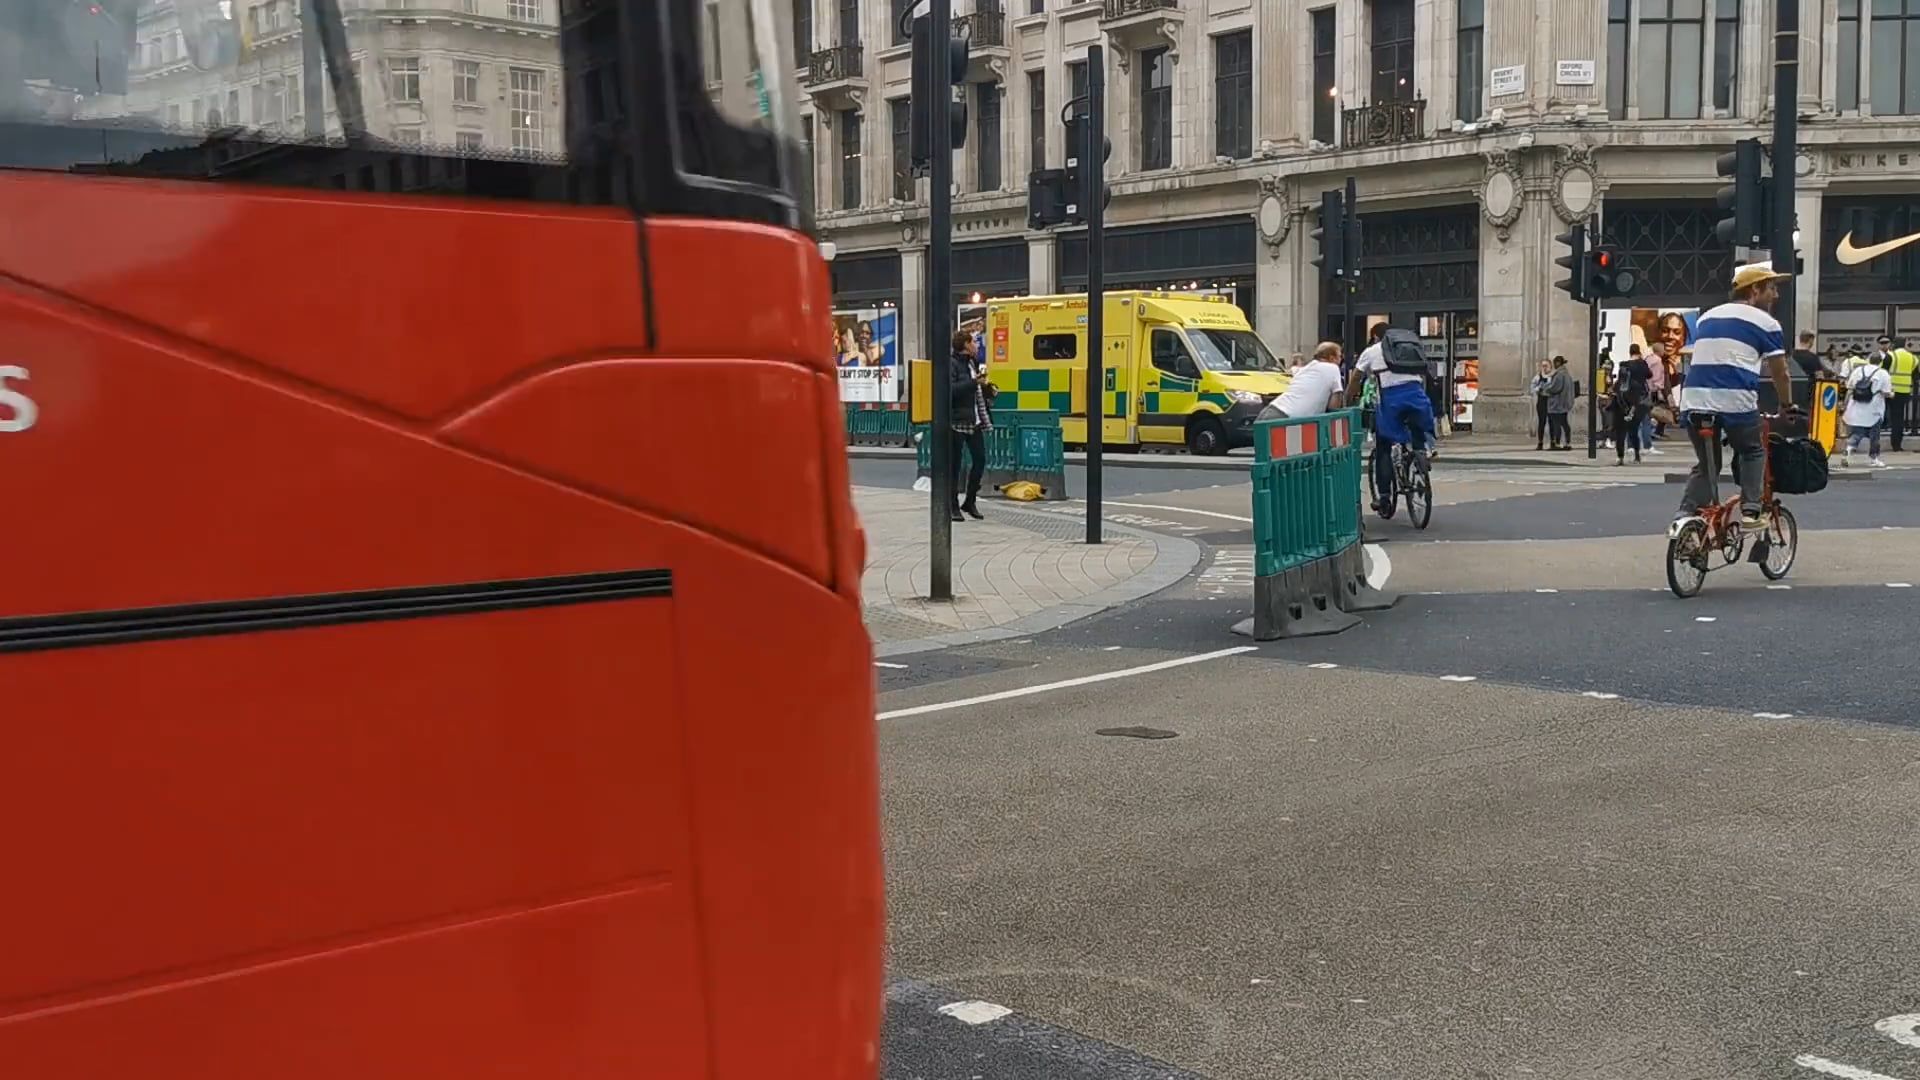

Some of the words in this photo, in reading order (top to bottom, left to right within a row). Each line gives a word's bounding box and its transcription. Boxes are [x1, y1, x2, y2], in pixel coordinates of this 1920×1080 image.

[1840, 153, 1920, 168] NIKE
[956, 218, 1010, 232] KETOWN
[1019, 303, 1049, 312] Emergency
[1066, 300, 1088, 309] Ambula
[857, 369, 872, 379] STOP
